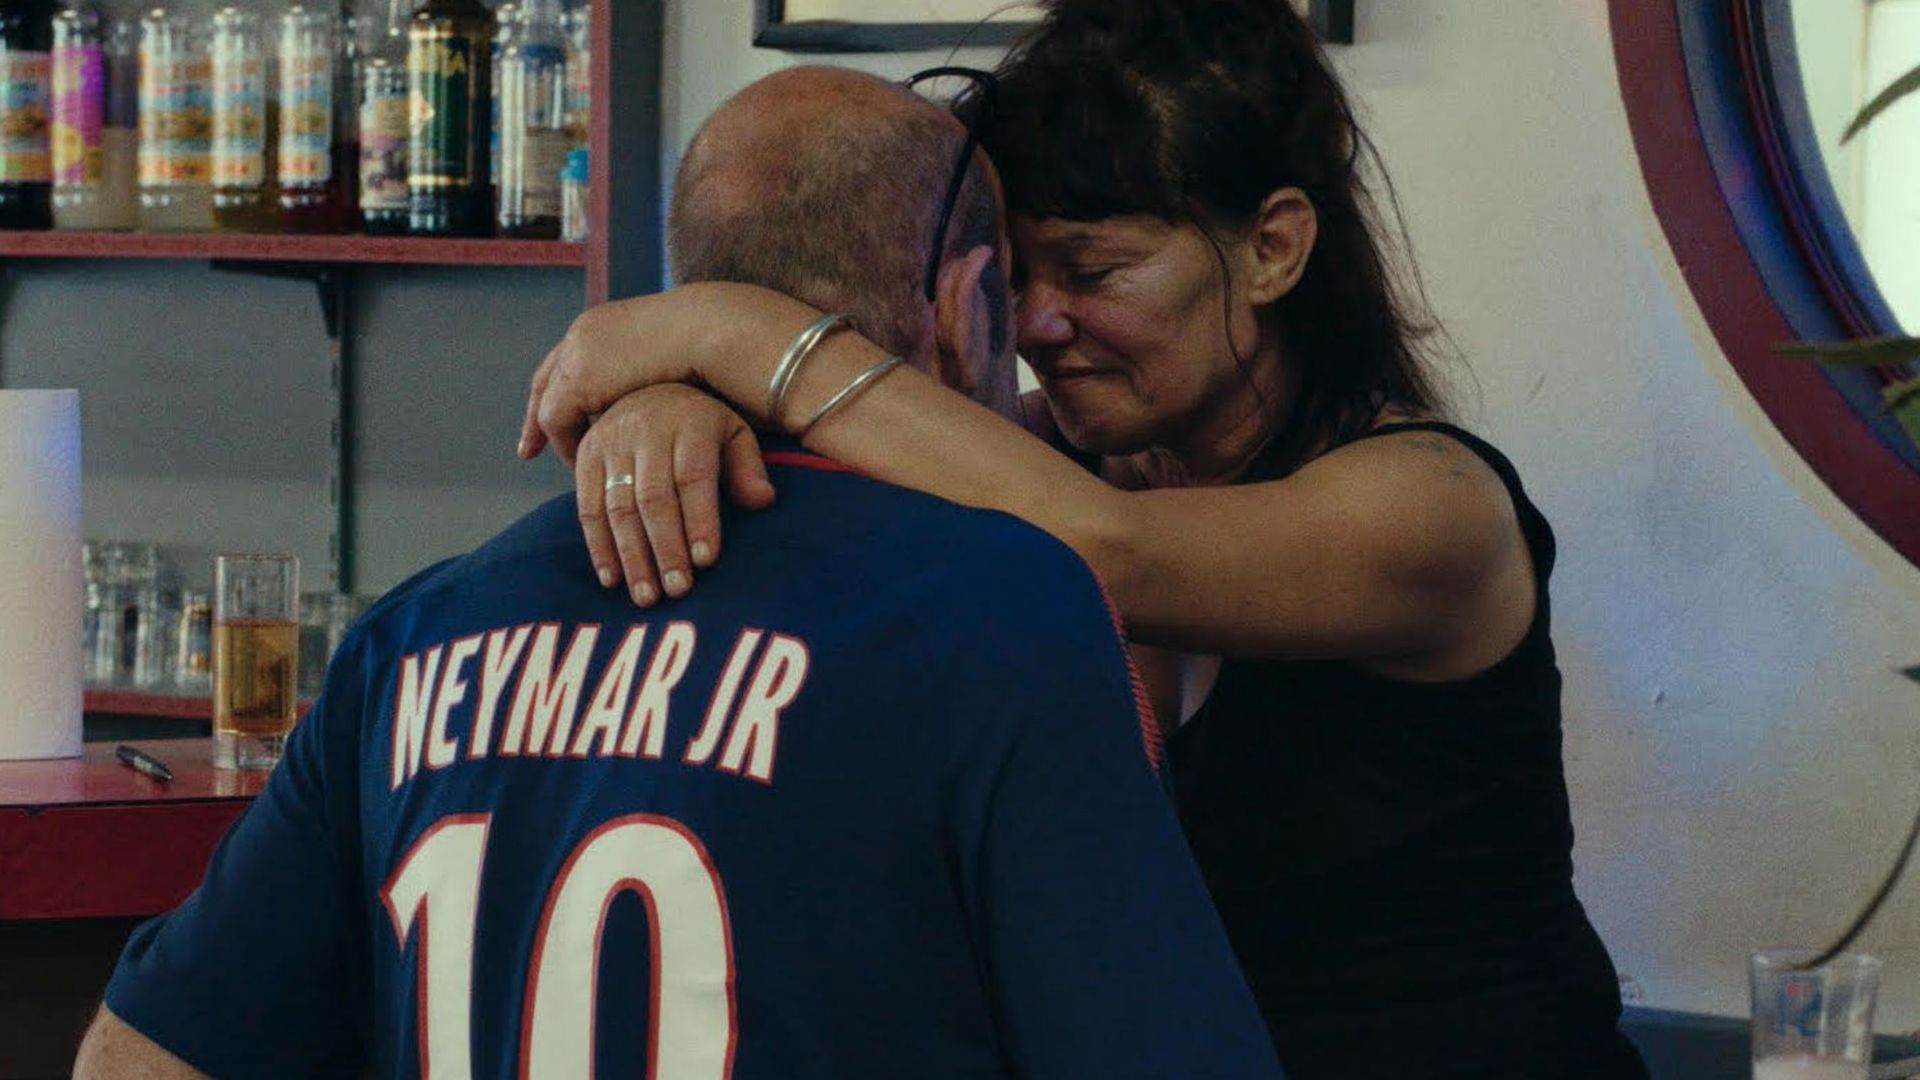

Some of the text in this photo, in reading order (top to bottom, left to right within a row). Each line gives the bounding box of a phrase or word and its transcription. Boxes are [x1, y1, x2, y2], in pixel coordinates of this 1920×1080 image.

[391, 620, 809, 791] NEYMAR JR
[380, 813, 737, 1080] 10
